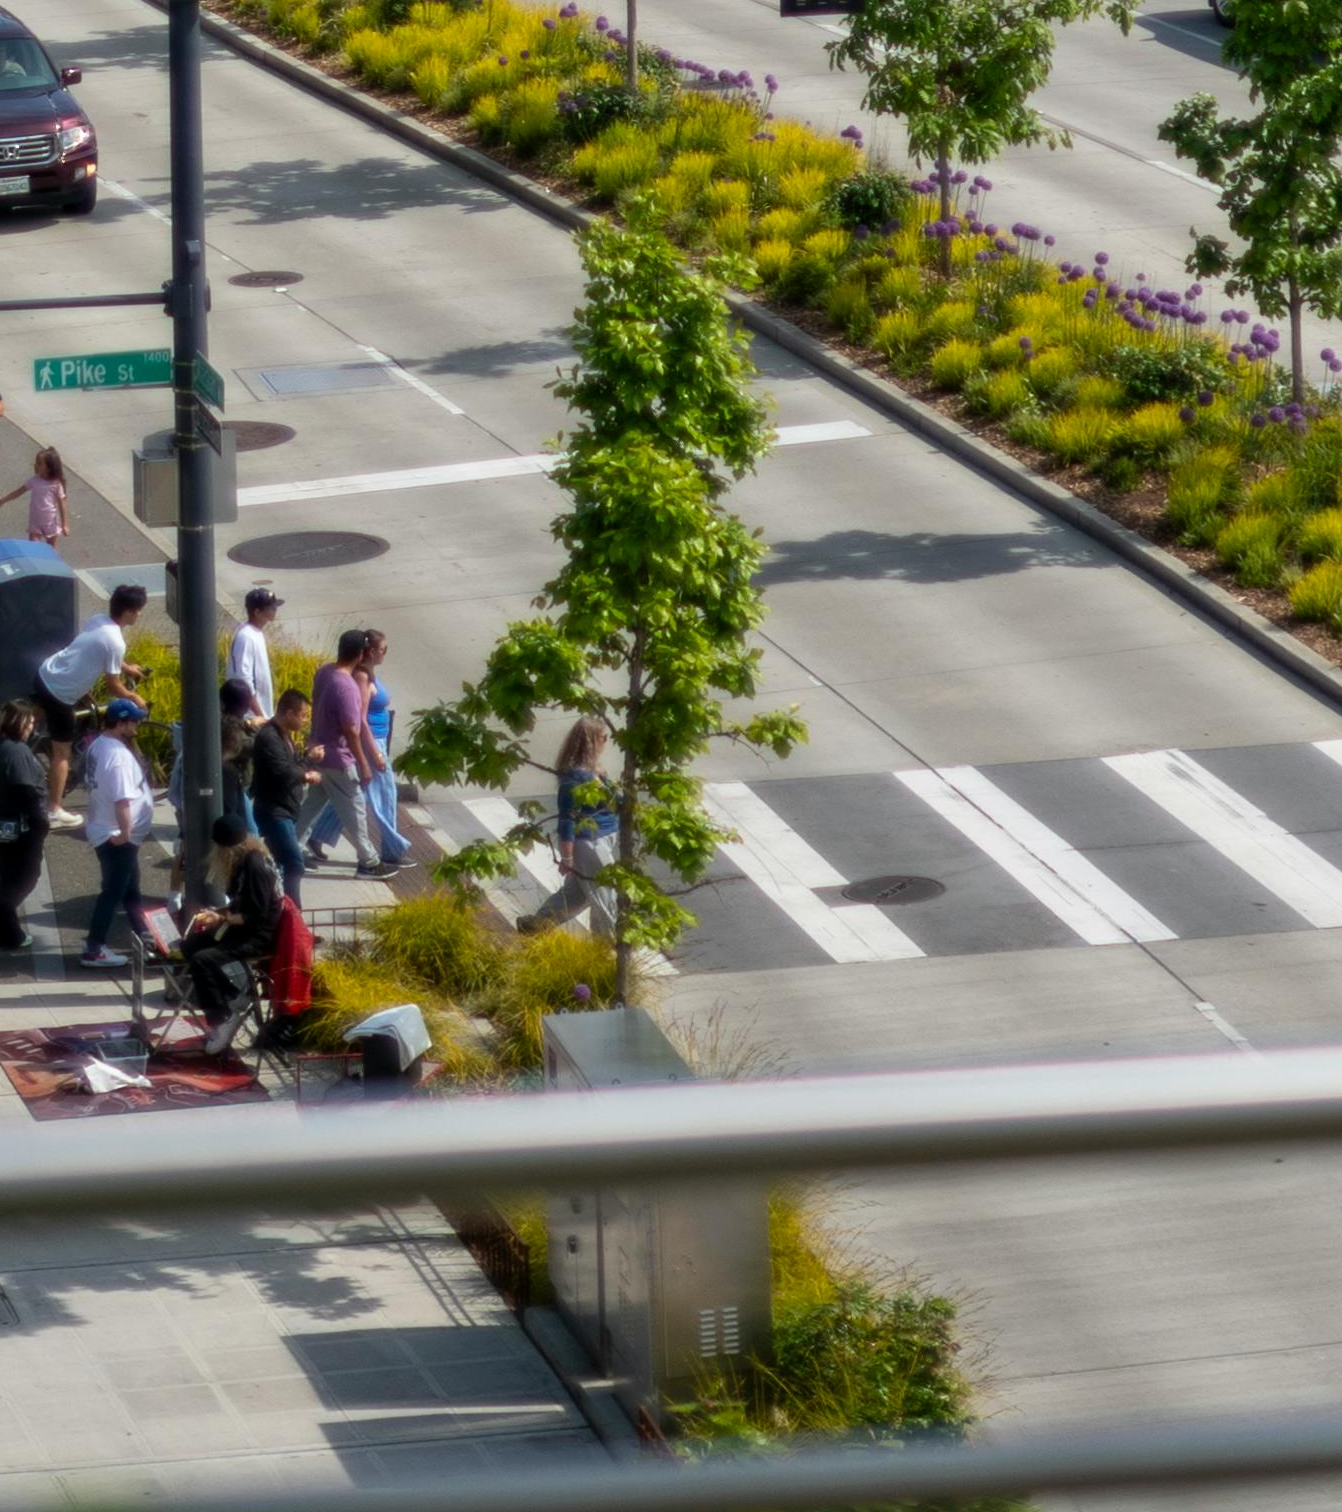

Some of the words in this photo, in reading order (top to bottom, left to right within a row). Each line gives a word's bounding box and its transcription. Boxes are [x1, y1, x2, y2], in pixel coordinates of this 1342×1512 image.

[143, 351, 170, 364] 1400
[60, 359, 107, 387] Pike
[117, 363, 135, 382] St
